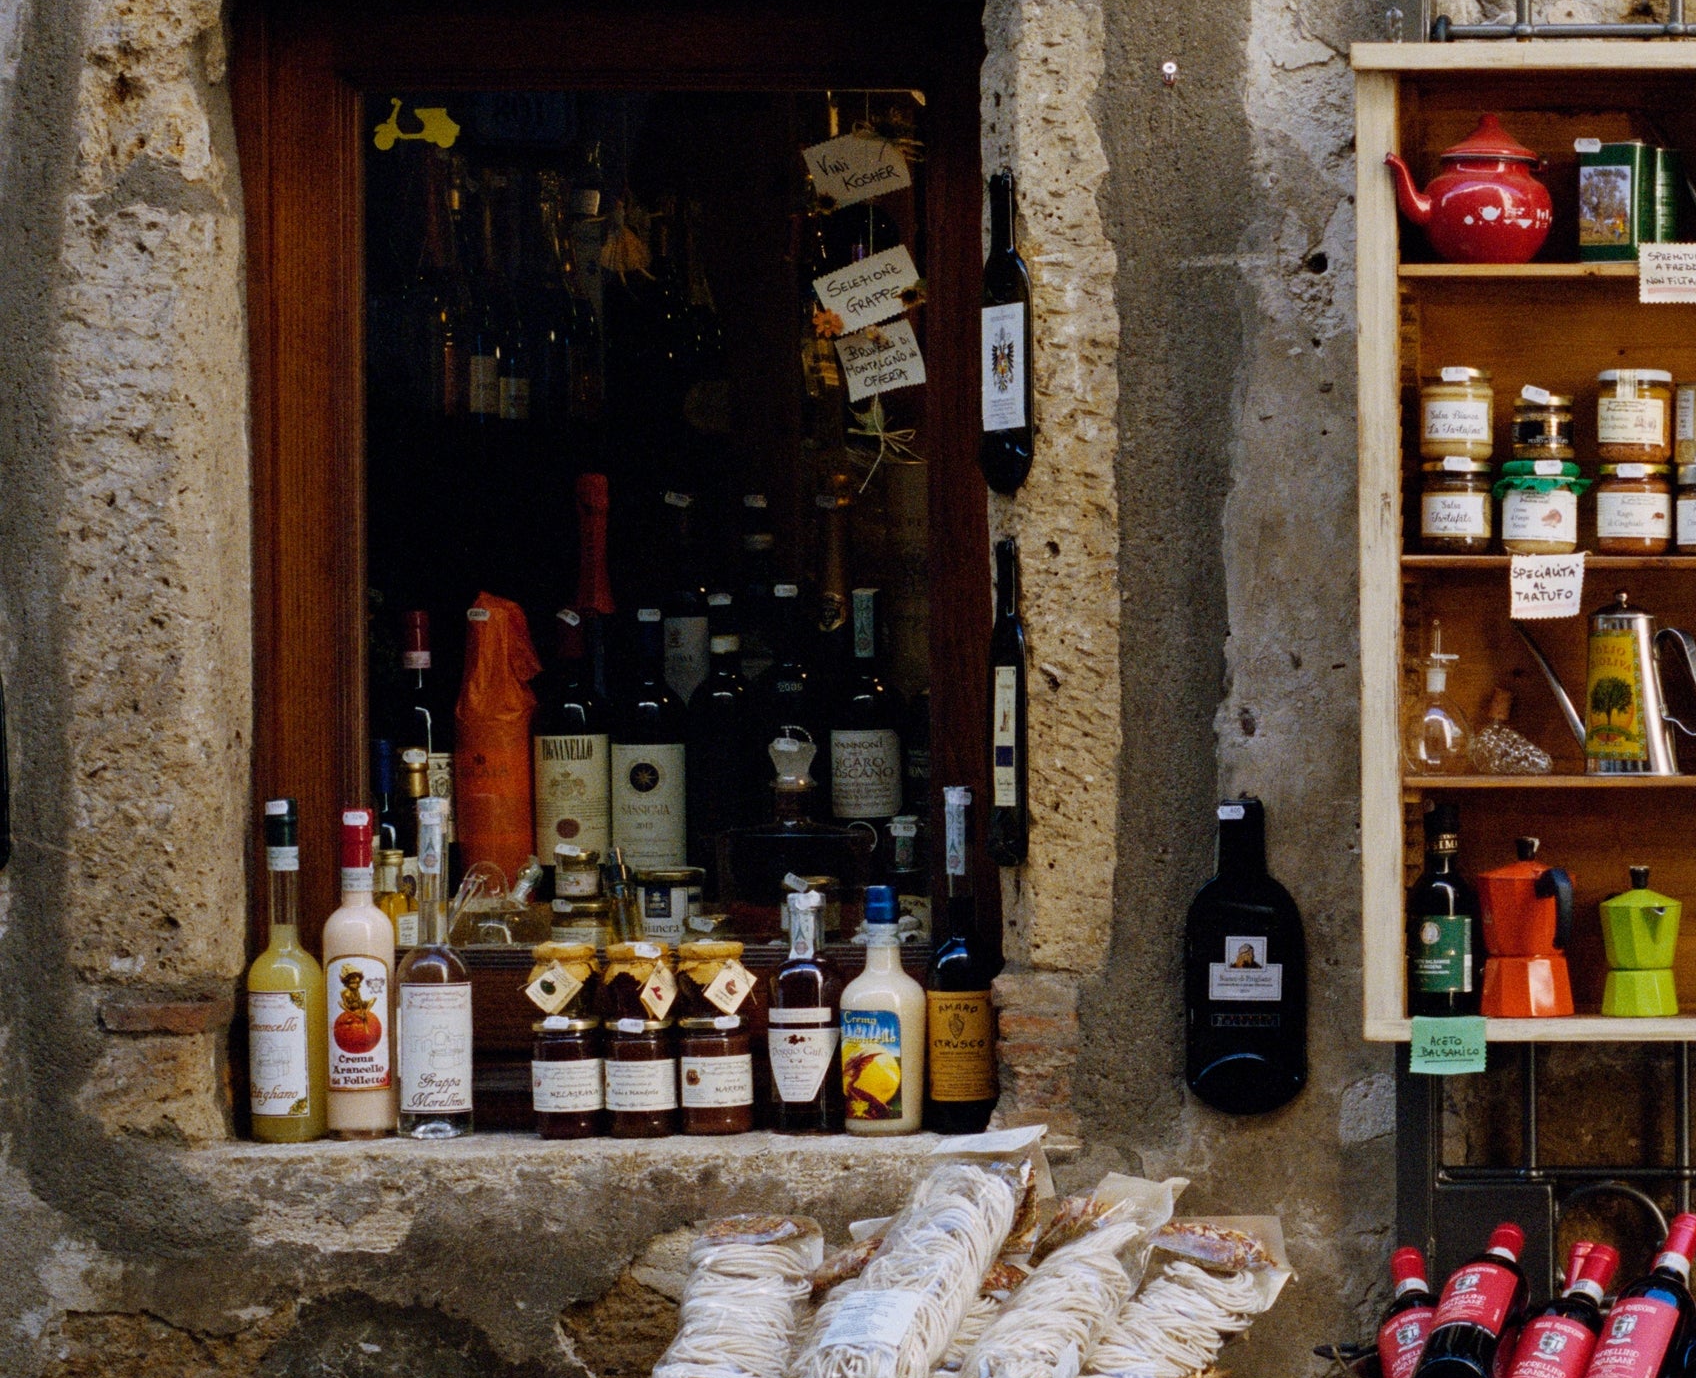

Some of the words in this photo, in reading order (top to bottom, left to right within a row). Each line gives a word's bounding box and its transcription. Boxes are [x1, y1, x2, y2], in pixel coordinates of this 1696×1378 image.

[843, 164, 900, 191] KOSHER
[827, 262, 902, 297] SELEZIONE
[1646, 277, 1665, 285] NON
[847, 286, 900, 316] GRAPPE
[863, 368, 908, 388] OFFERTA
[1515, 590, 1573, 601] TARTUFO
[939, 1004, 978, 1013] AMARO
[1431, 1036, 1462, 1046] ACETO
[1418, 1046, 1480, 1058] BALSAMICO
[339, 1054, 374, 1063] Crema
[332, 1064, 384, 1075] Arancello
[343, 1075, 386, 1085] Folletto
[418, 1072, 461, 1095] Grappa
